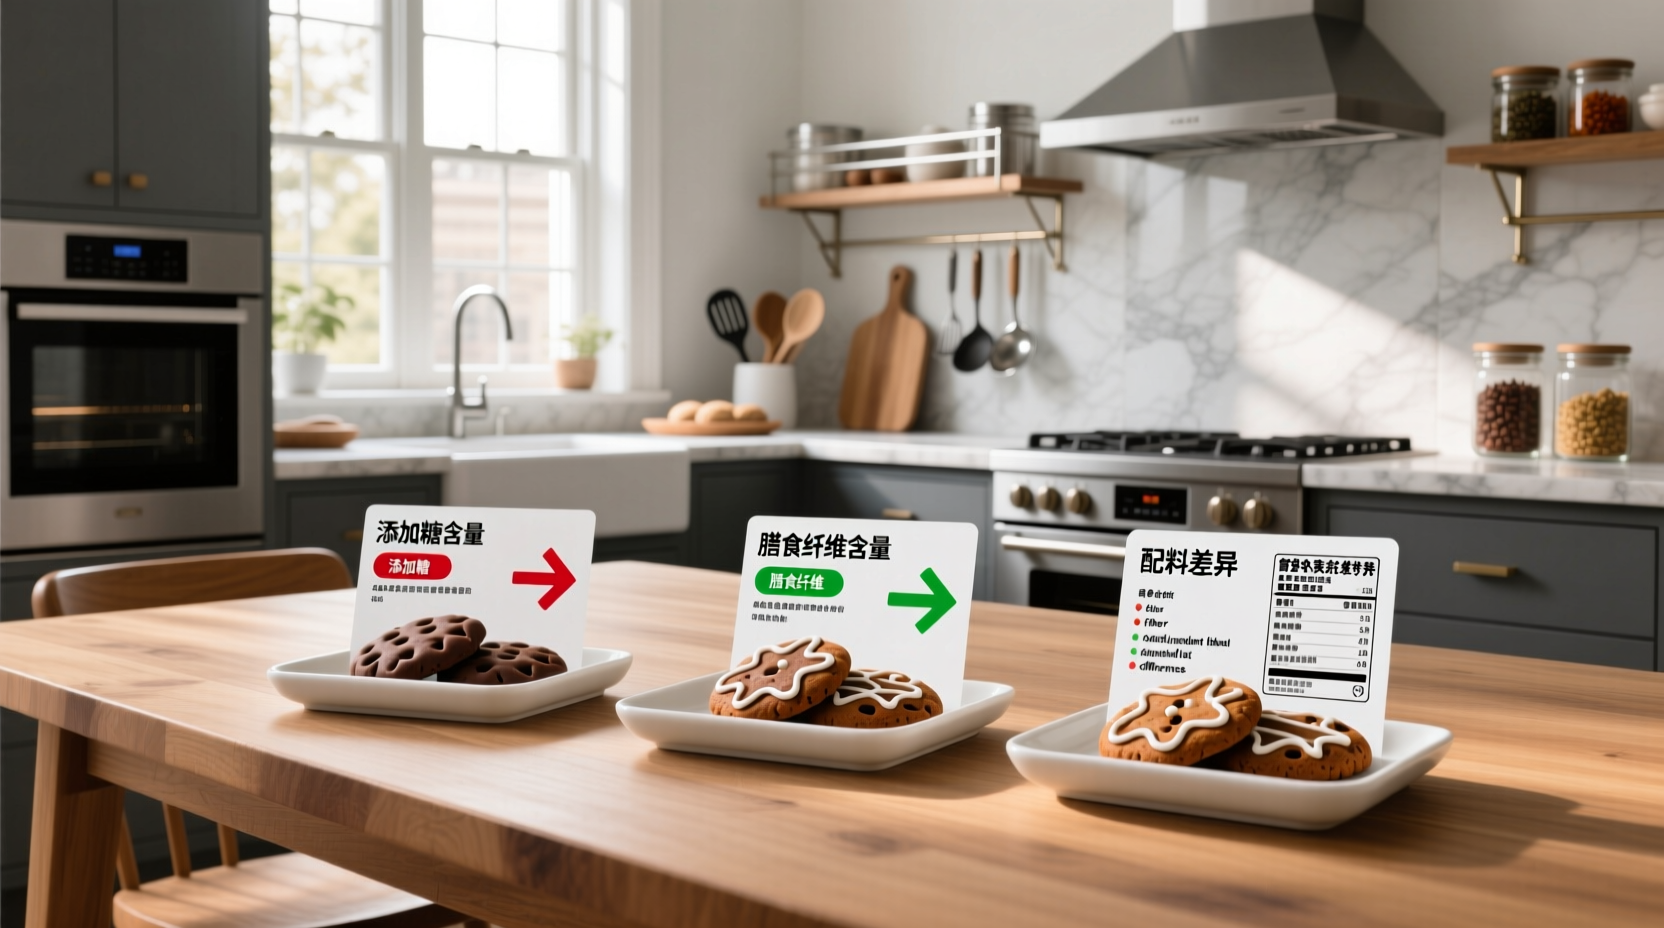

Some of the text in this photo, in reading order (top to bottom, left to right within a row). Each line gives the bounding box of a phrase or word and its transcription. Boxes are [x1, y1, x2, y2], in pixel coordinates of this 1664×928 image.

[376, 519, 485, 546] 添加糖含量
[757, 531, 892, 560] 膳食纤维含量
[388, 558, 430, 576] 添加糖
[1140, 547, 1238, 577] 配料差异
[769, 572, 824, 590] 膳食纤维
